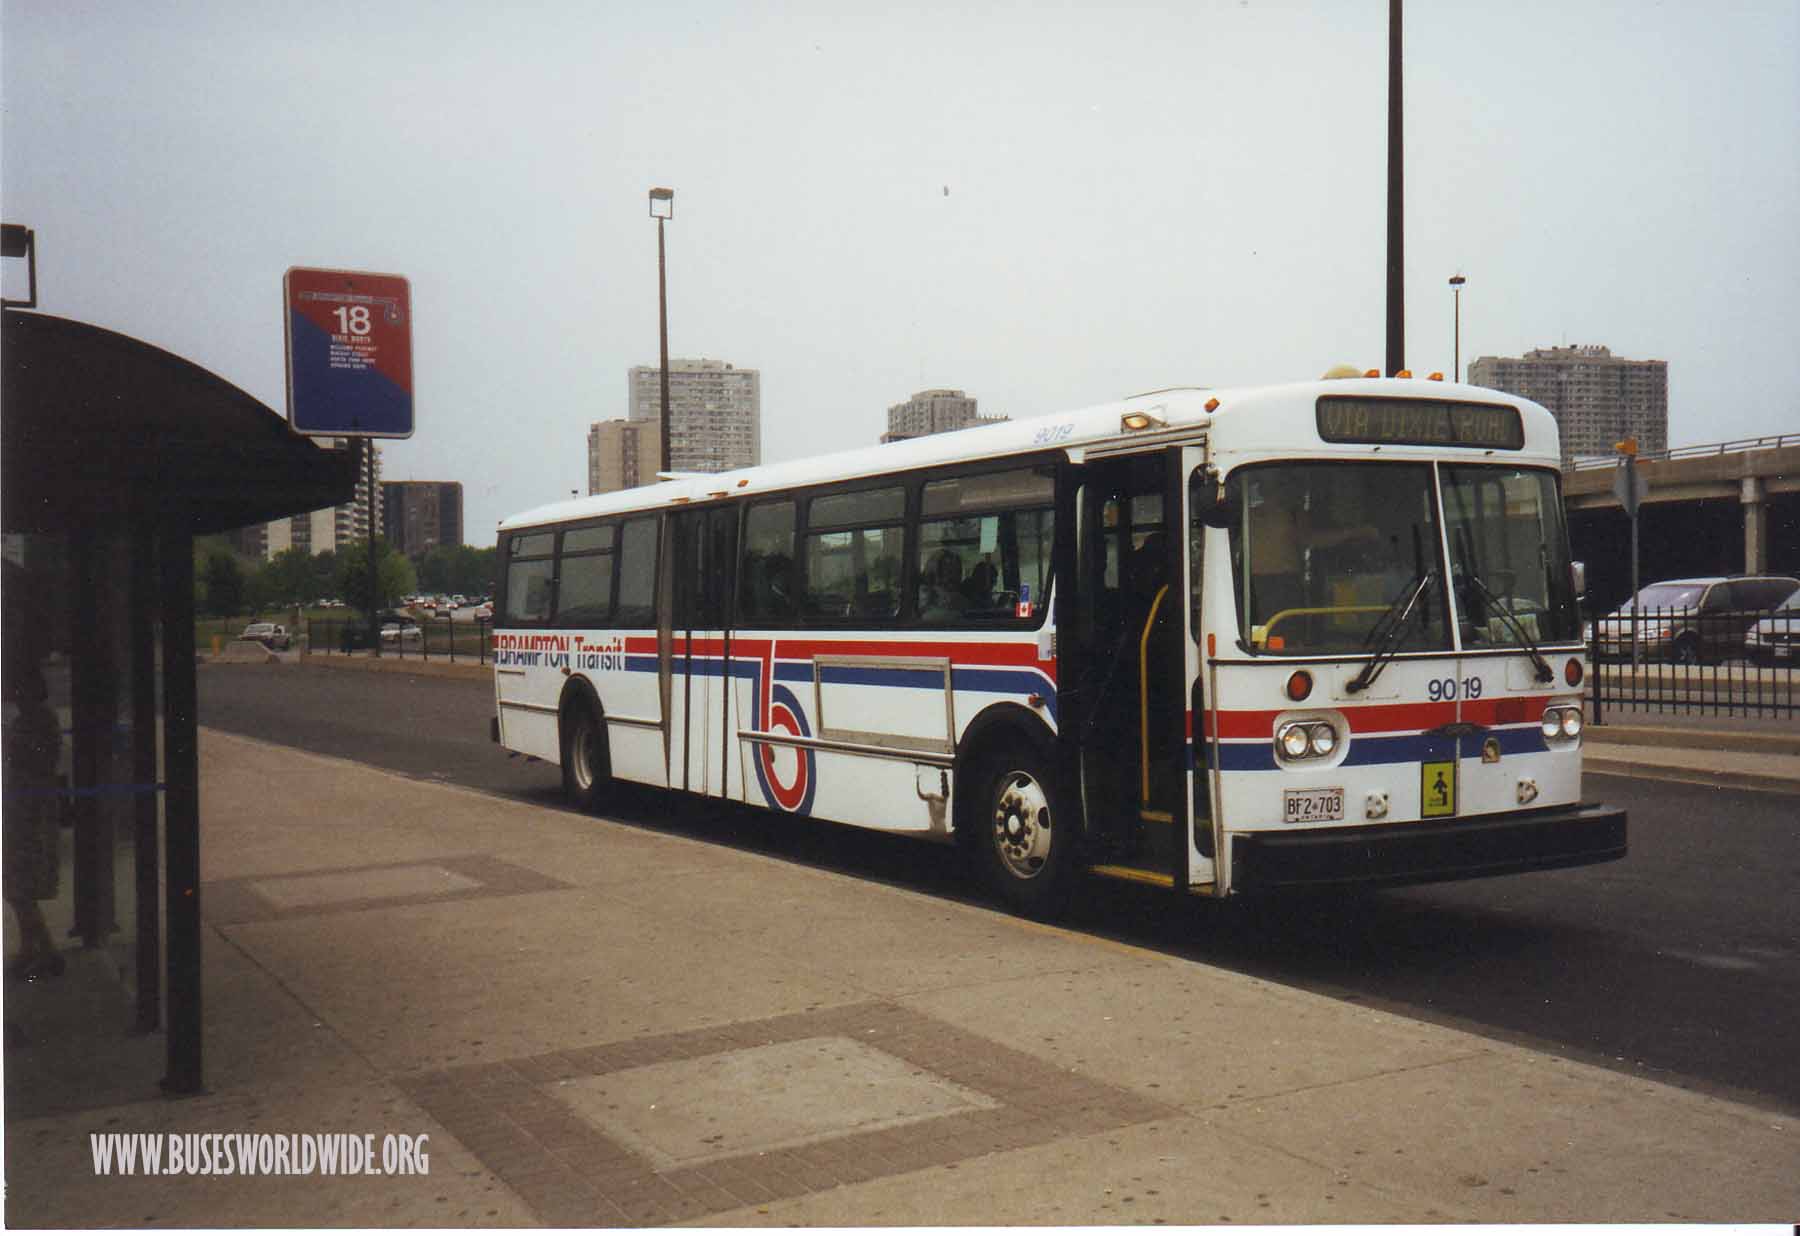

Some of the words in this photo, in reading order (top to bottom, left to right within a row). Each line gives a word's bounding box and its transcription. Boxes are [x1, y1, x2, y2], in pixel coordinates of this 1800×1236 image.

[333, 306, 371, 335] 18
[1327, 404, 1368, 438] VIA
[500, 634, 570, 668] BRAMPTON
[574, 636, 622, 670] Transit
[1428, 676, 1482, 701] 9019
